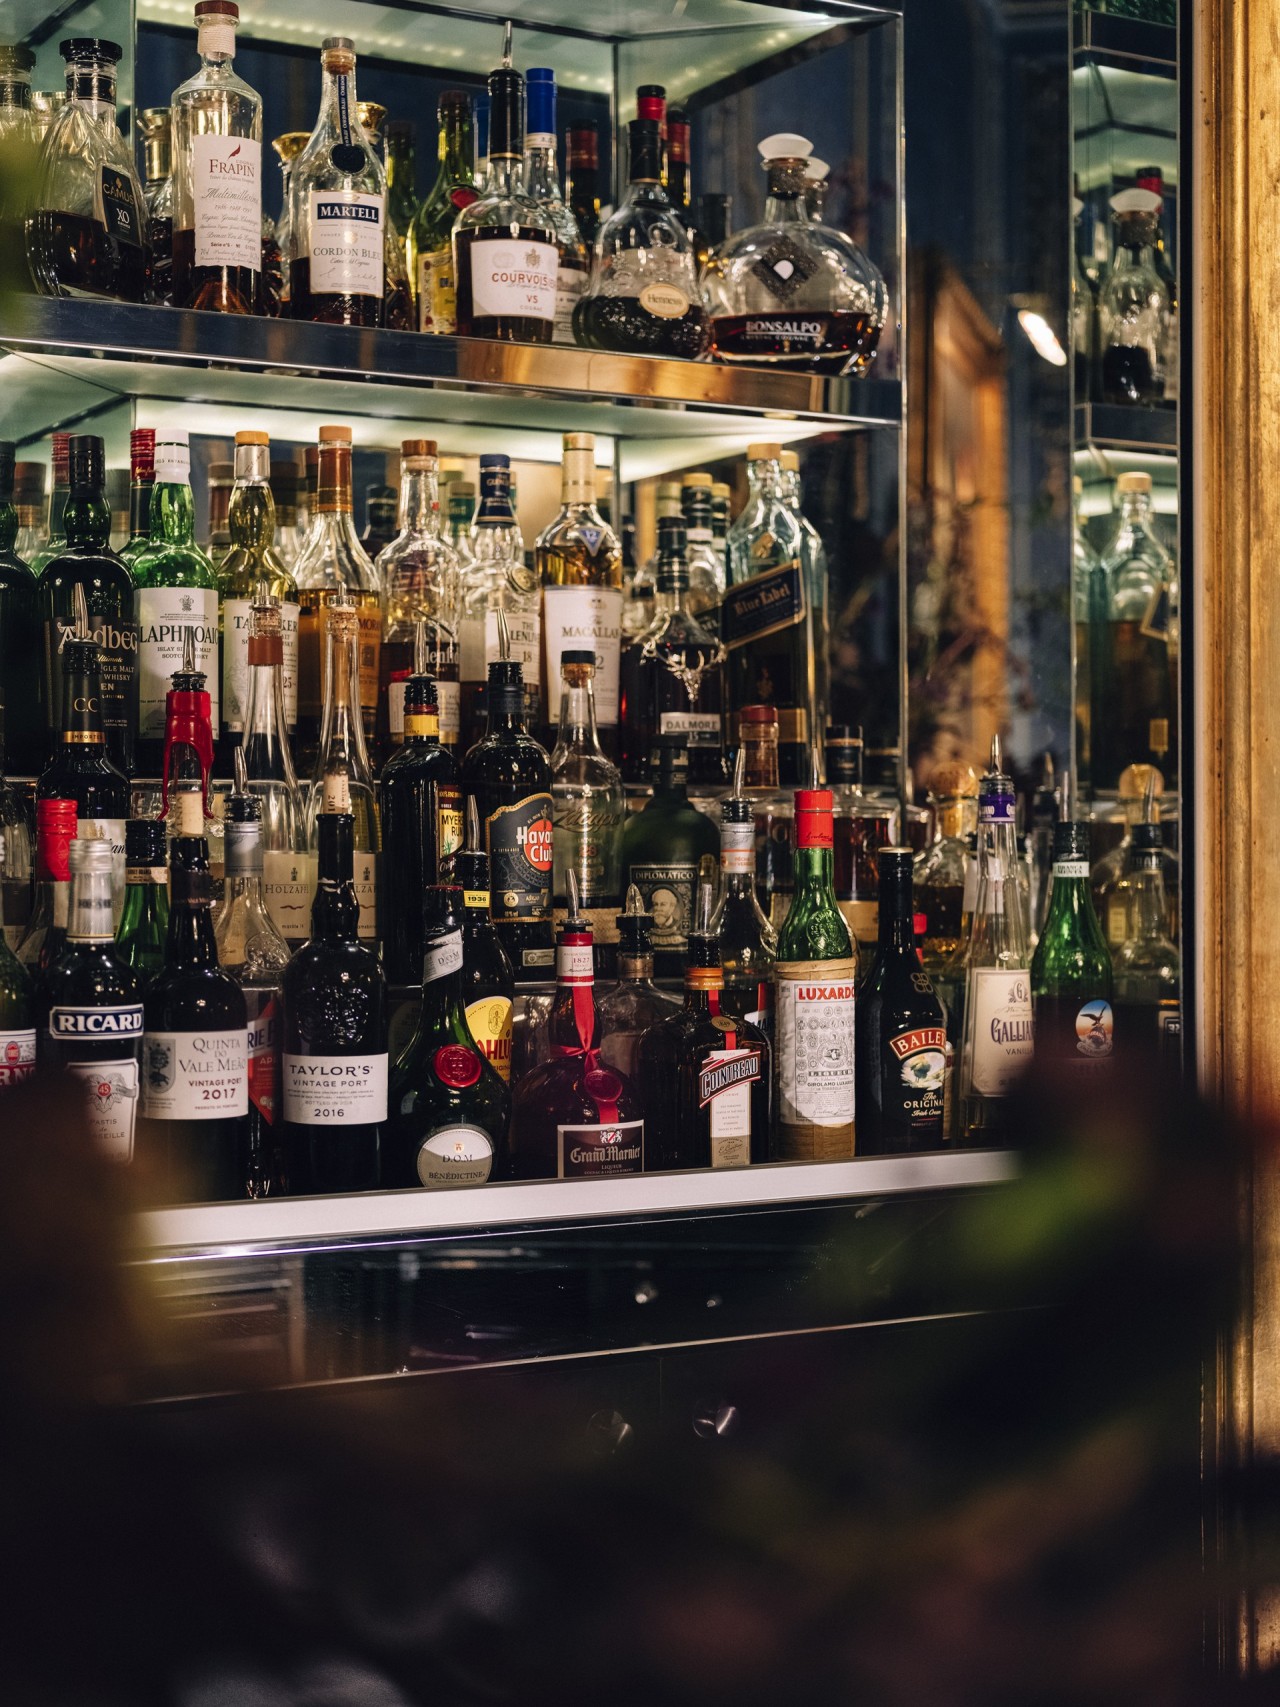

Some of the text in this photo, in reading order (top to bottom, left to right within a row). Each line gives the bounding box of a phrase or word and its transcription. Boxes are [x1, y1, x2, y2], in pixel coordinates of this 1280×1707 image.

[209, 159, 255, 177] FRAPIN
[103, 183, 135, 205] CAMUS
[116, 207, 130, 224] XO
[320, 205, 378, 220] MARTELL
[313, 247, 359, 256] CORDON
[527, 295, 538, 303] VS
[746, 321, 821, 333] BONSALPO
[734, 583, 790, 616] Blue Label
[233, 615, 297, 632] TAKER
[57, 622, 137, 654] Adbeg
[139, 625, 219, 644] LAPHOAI
[523, 652, 532, 662] 18
[104, 673, 131, 681] WHISKY
[100, 683, 115, 691] EN
[666, 720, 718, 730] DALMORE
[58, 1014, 142, 1031] RICARD
[192, 1038, 240, 1053] QUINTA
[179, 1059, 214, 1073] VALE
[290, 1065, 371, 1077] TAYLOR'S
[293, 1079, 337, 1087] VINTAGE
[702, 1056, 759, 1099] COINTREAU
[99, 1085, 110, 1095] 45
[202, 1088, 236, 1100] 2017
[922, 1092, 937, 1101] The
[314, 1109, 345, 1117] 2016
[911, 1109, 928, 1117] Irish
[443, 1154, 473, 1163] D.O.M
[570, 1144, 641, 1163] Grand Marnier
[429, 1171, 482, 1180] BÉNÉDICTINE
